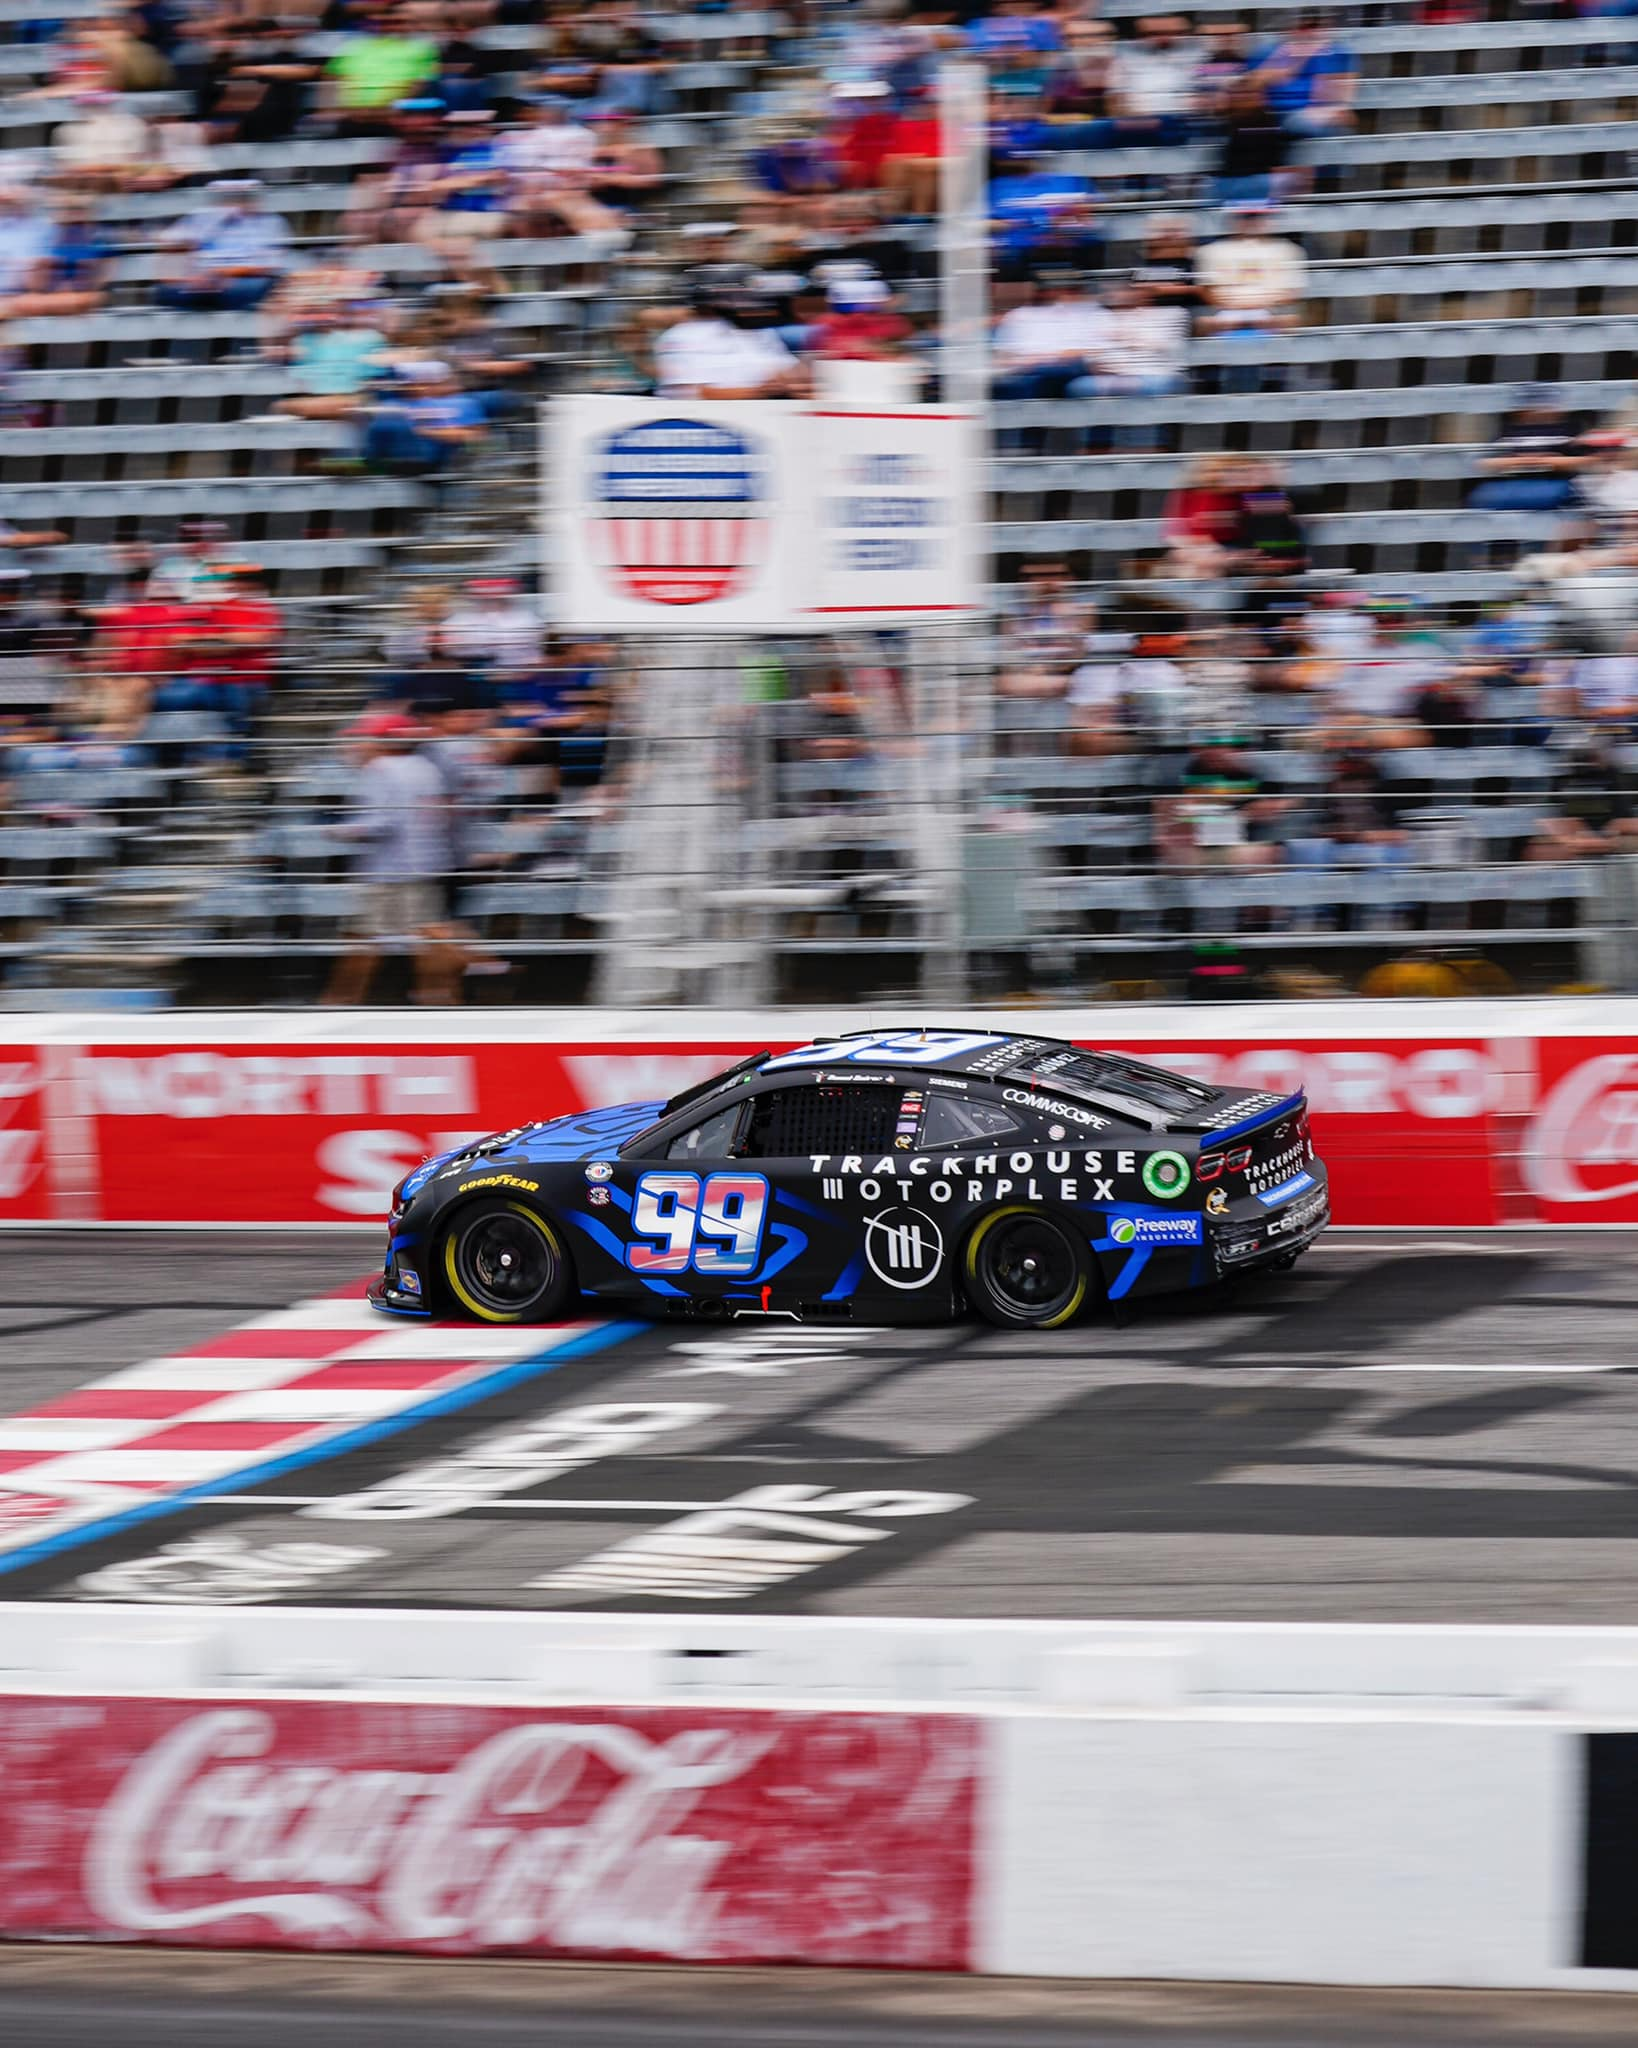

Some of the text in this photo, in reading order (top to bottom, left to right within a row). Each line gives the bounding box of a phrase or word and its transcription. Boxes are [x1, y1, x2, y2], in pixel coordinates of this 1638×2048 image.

[74, 1053, 477, 1118] NORTH
[1002, 1088, 1112, 1130] COMMSCOPE
[809, 1149, 1136, 1176] TRACKHOUSE
[458, 1173, 540, 1193] GOODYEAR
[624, 1170, 770, 1276] 99
[1134, 1217, 1198, 1235] Freeway
[1135, 1232, 1199, 1242] INSURANCE
